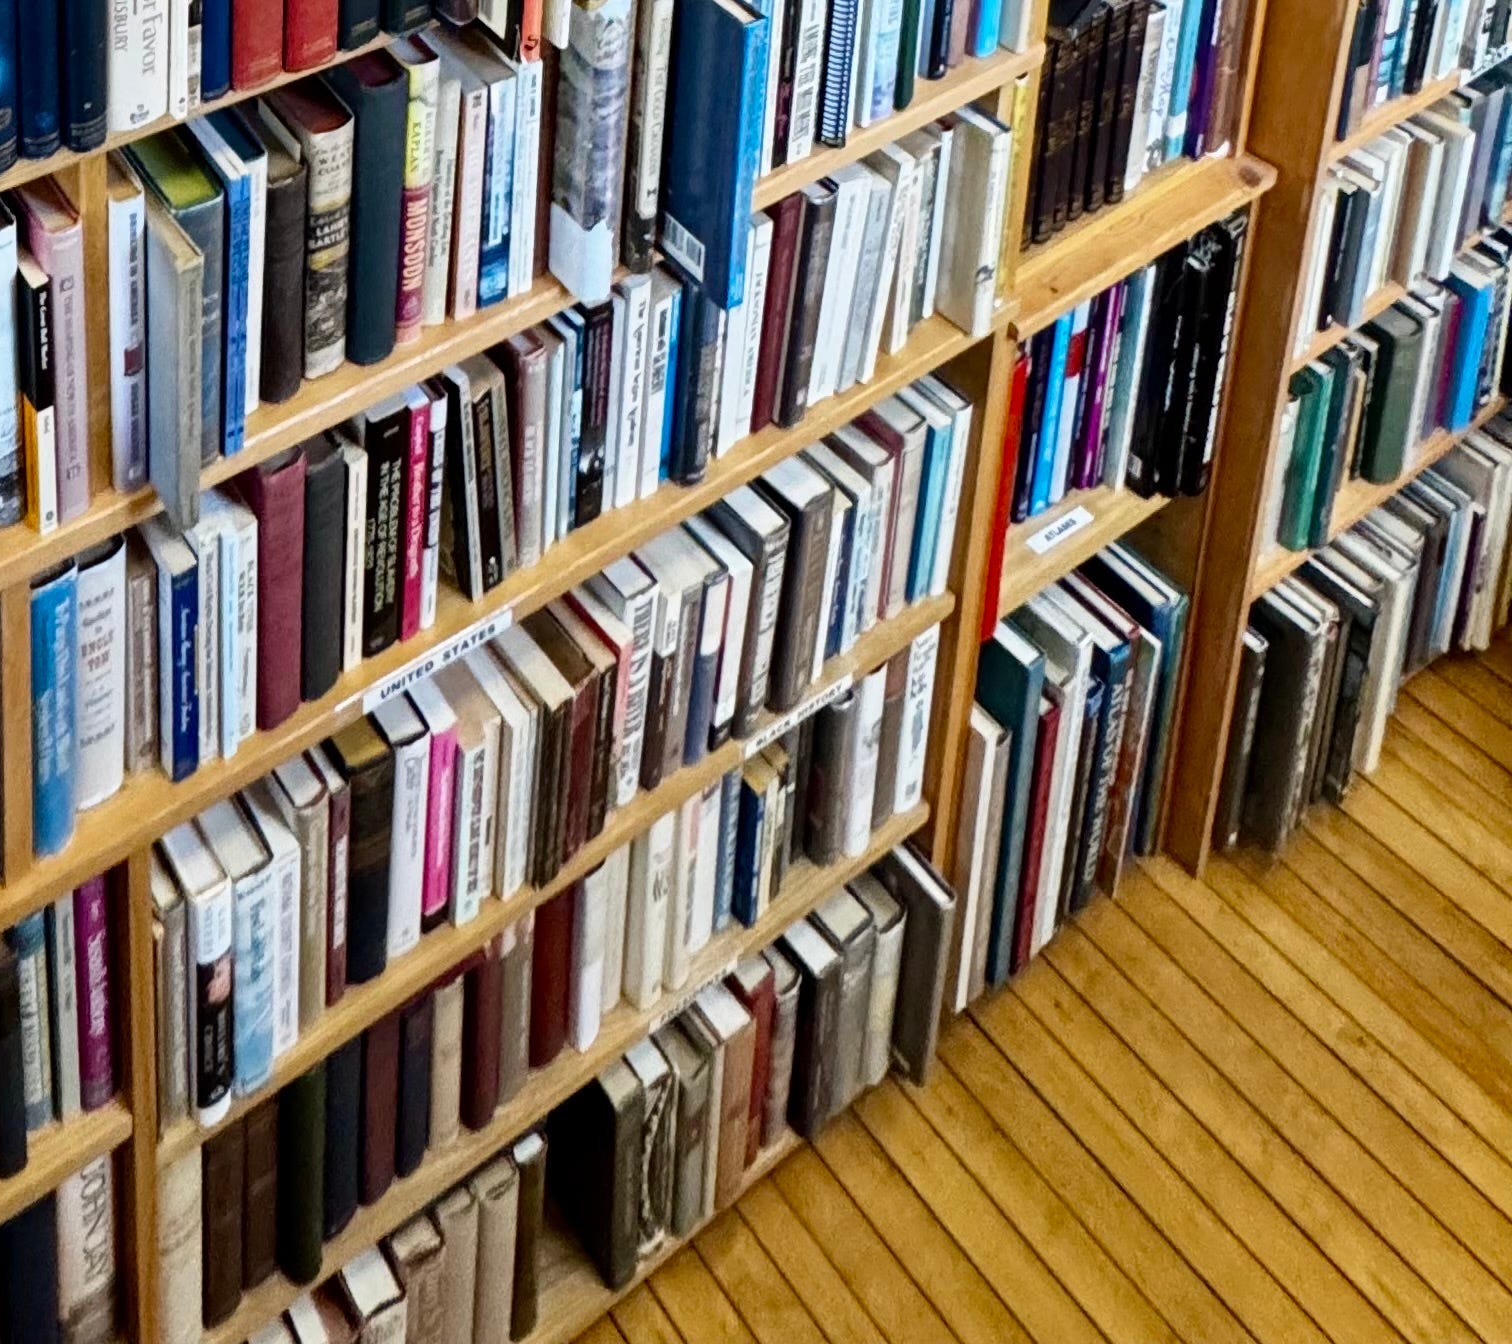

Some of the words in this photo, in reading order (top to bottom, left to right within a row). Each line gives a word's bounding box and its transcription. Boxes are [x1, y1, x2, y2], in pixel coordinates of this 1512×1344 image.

[141, 15, 164, 76] Favor
[401, 197, 429, 291] MONSOON
[379, 659, 435, 700] UNITED
[441, 623, 497, 663] STATES
